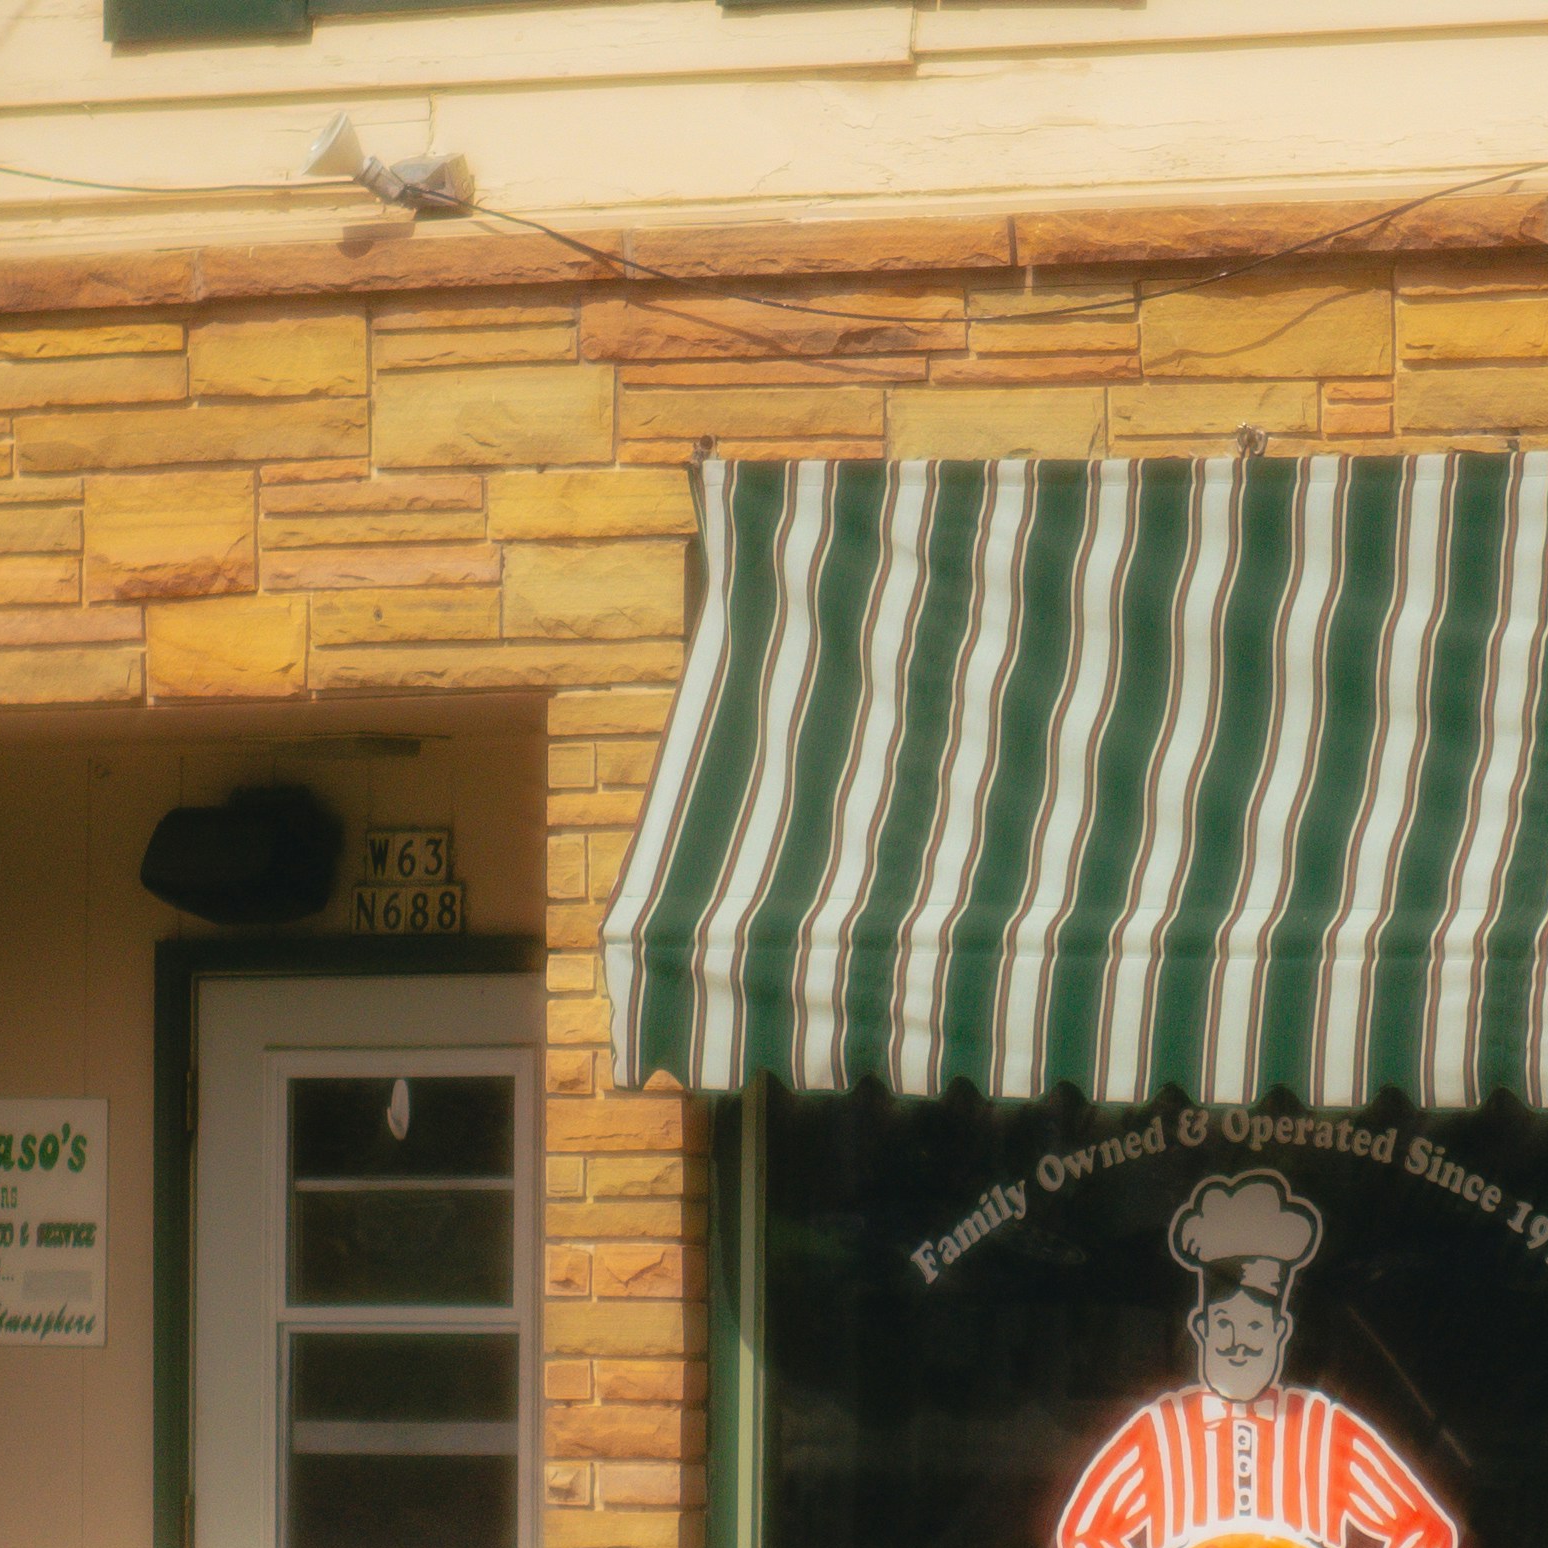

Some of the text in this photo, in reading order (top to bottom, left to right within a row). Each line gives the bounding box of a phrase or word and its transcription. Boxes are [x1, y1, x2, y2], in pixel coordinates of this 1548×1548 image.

[369, 838, 446, 878] W63
[356, 892, 458, 931] N688
[910, 1181, 1029, 1284] Family
[1037, 1118, 1165, 1193] Owned
[1182, 1108, 1209, 1145] &
[1221, 1109, 1394, 1164] Operated
[1405, 1136, 1503, 1213] Since
[37, 1222, 97, 1248] SERVICE
